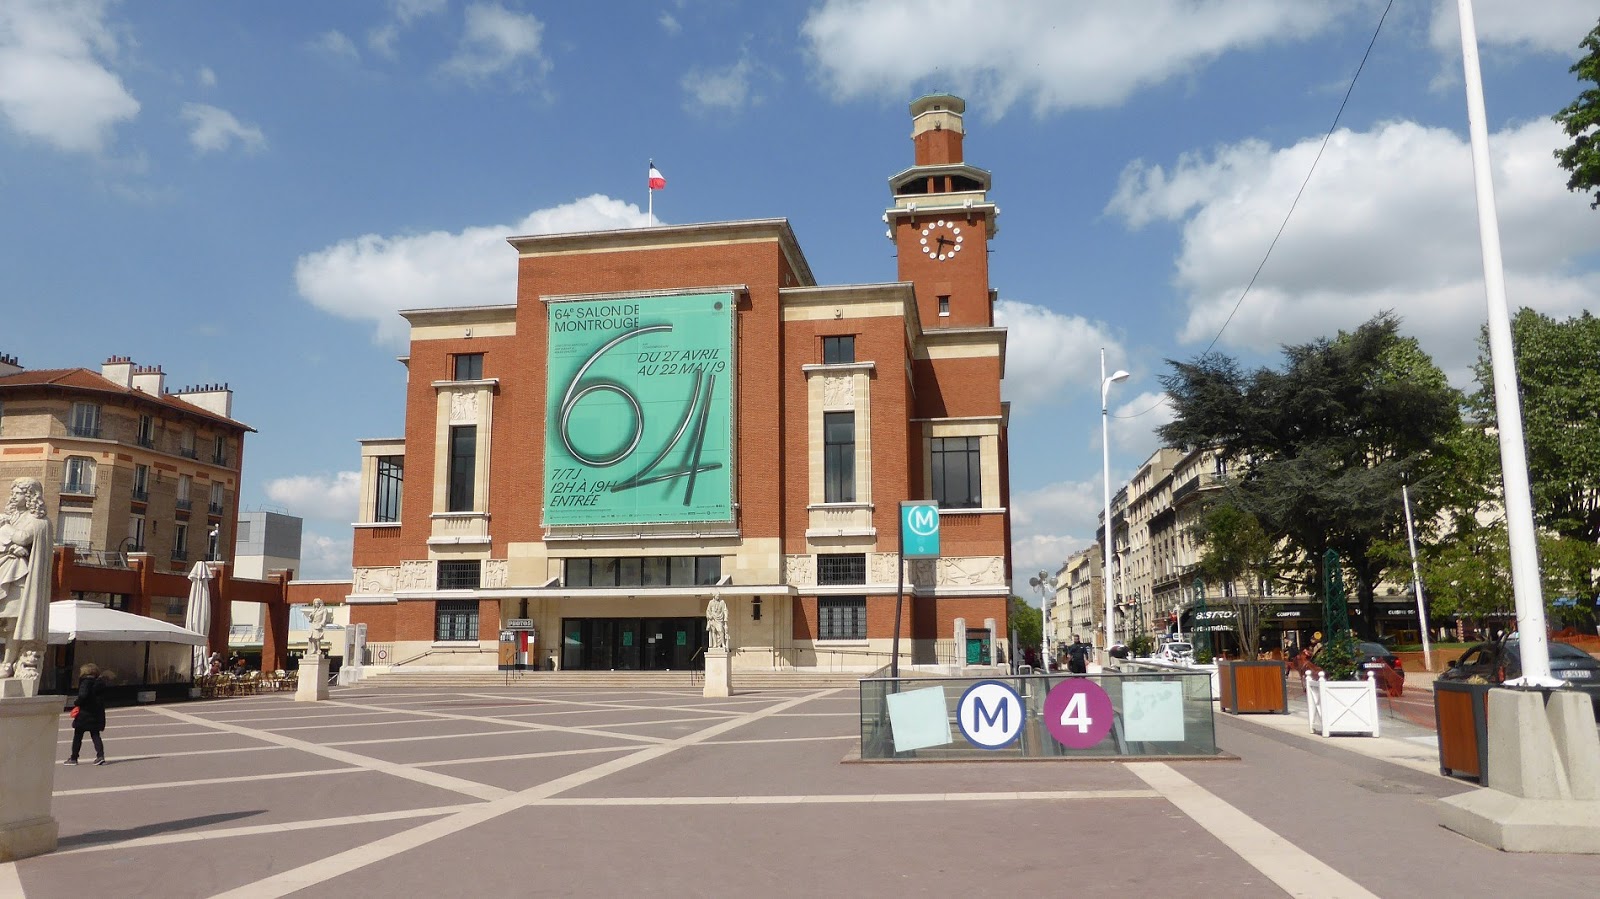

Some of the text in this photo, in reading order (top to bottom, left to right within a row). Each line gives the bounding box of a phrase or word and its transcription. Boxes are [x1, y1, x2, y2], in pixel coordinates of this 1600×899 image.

[576, 306, 621, 319] SALON
[623, 304, 640, 316] DE
[554, 317, 639, 333] MONTROUGE
[637, 348, 720, 363] DU 27 AVRIL
[637, 361, 726, 376] AU 22 MAI 19
[551, 468, 583, 480] 7/7J
[550, 478, 618, 494] 12H À 19H
[549, 492, 601, 507] ENTRÉE
[915, 509, 934, 529] M
[973, 696, 1008, 733] M
[1060, 692, 1092, 734] 4
